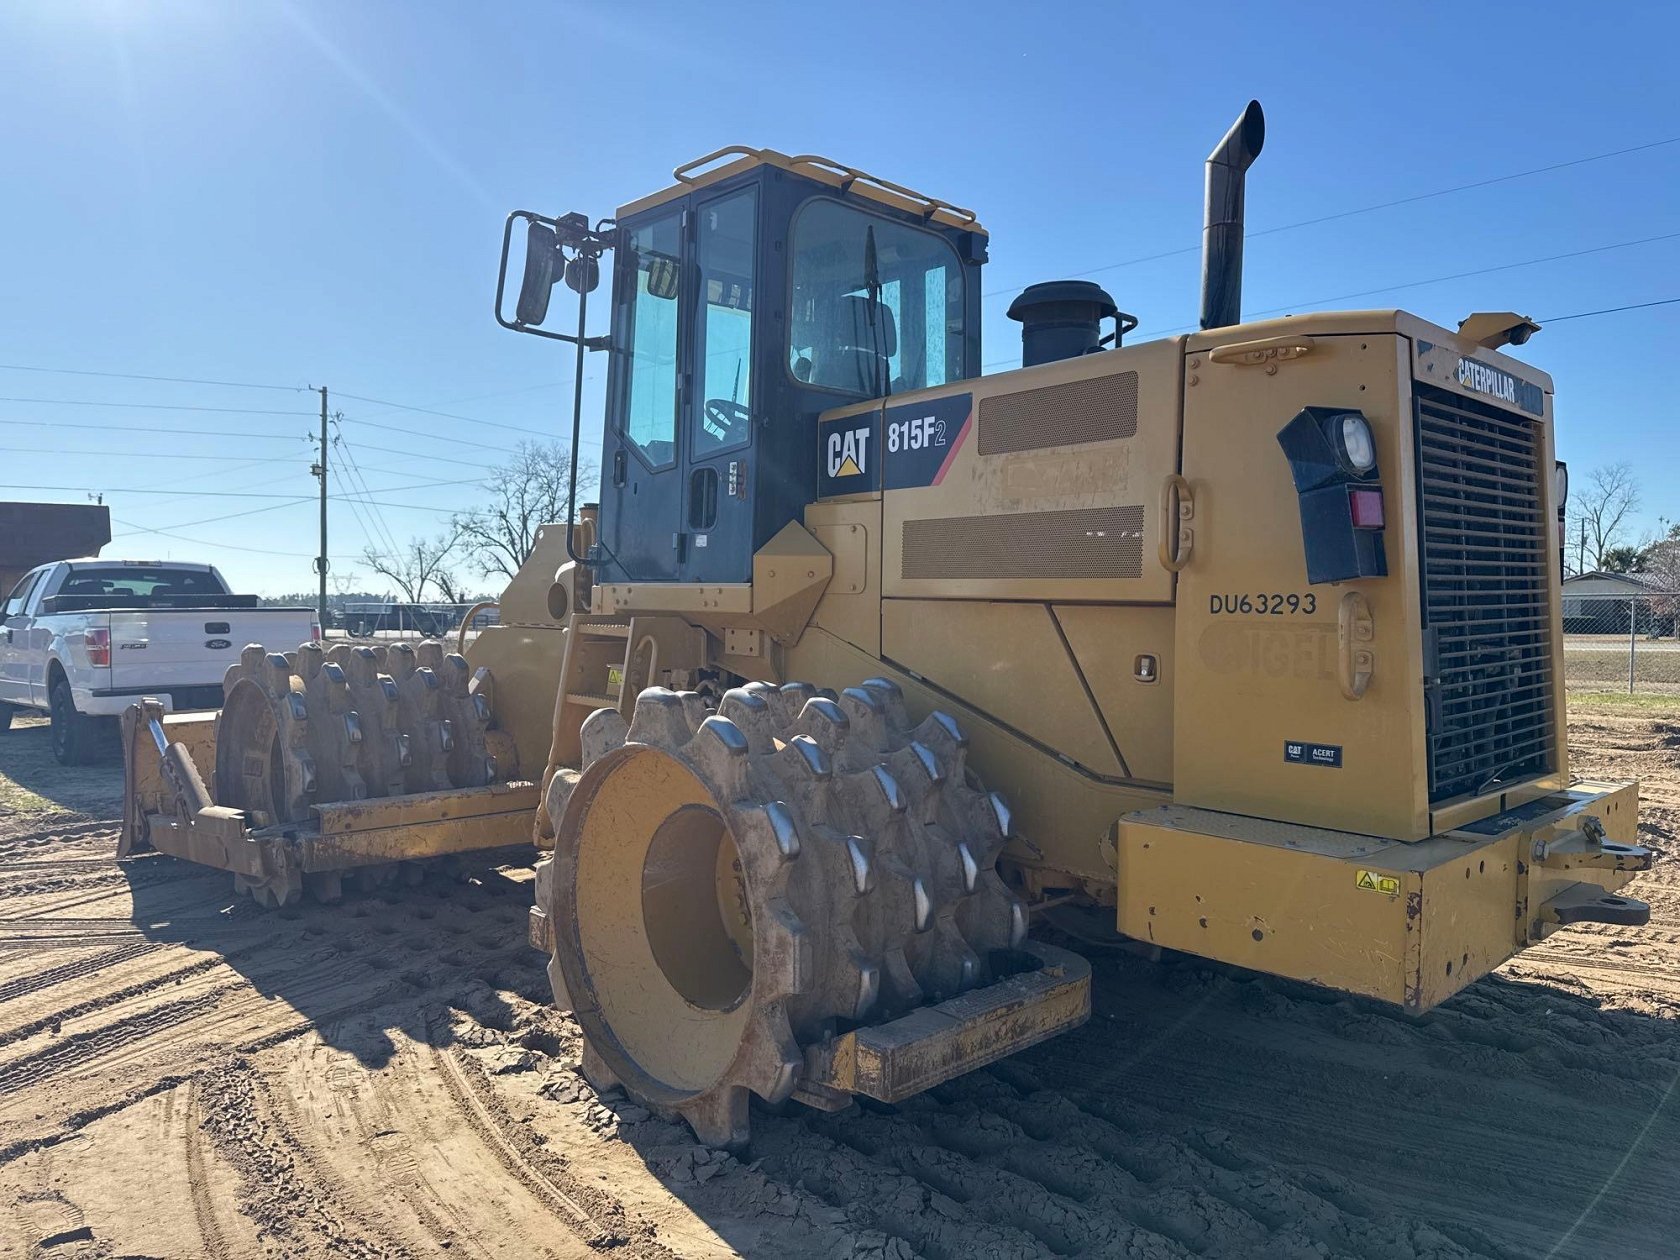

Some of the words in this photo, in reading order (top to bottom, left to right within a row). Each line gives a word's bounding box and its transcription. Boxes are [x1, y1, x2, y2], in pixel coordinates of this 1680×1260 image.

[1458, 358, 1515, 403] CATERPILLAR
[827, 428, 870, 478] CAT
[1210, 593, 1317, 615] DU63293
[1288, 745, 1302, 755] CAT
[1312, 748, 1335, 757] ACERT
